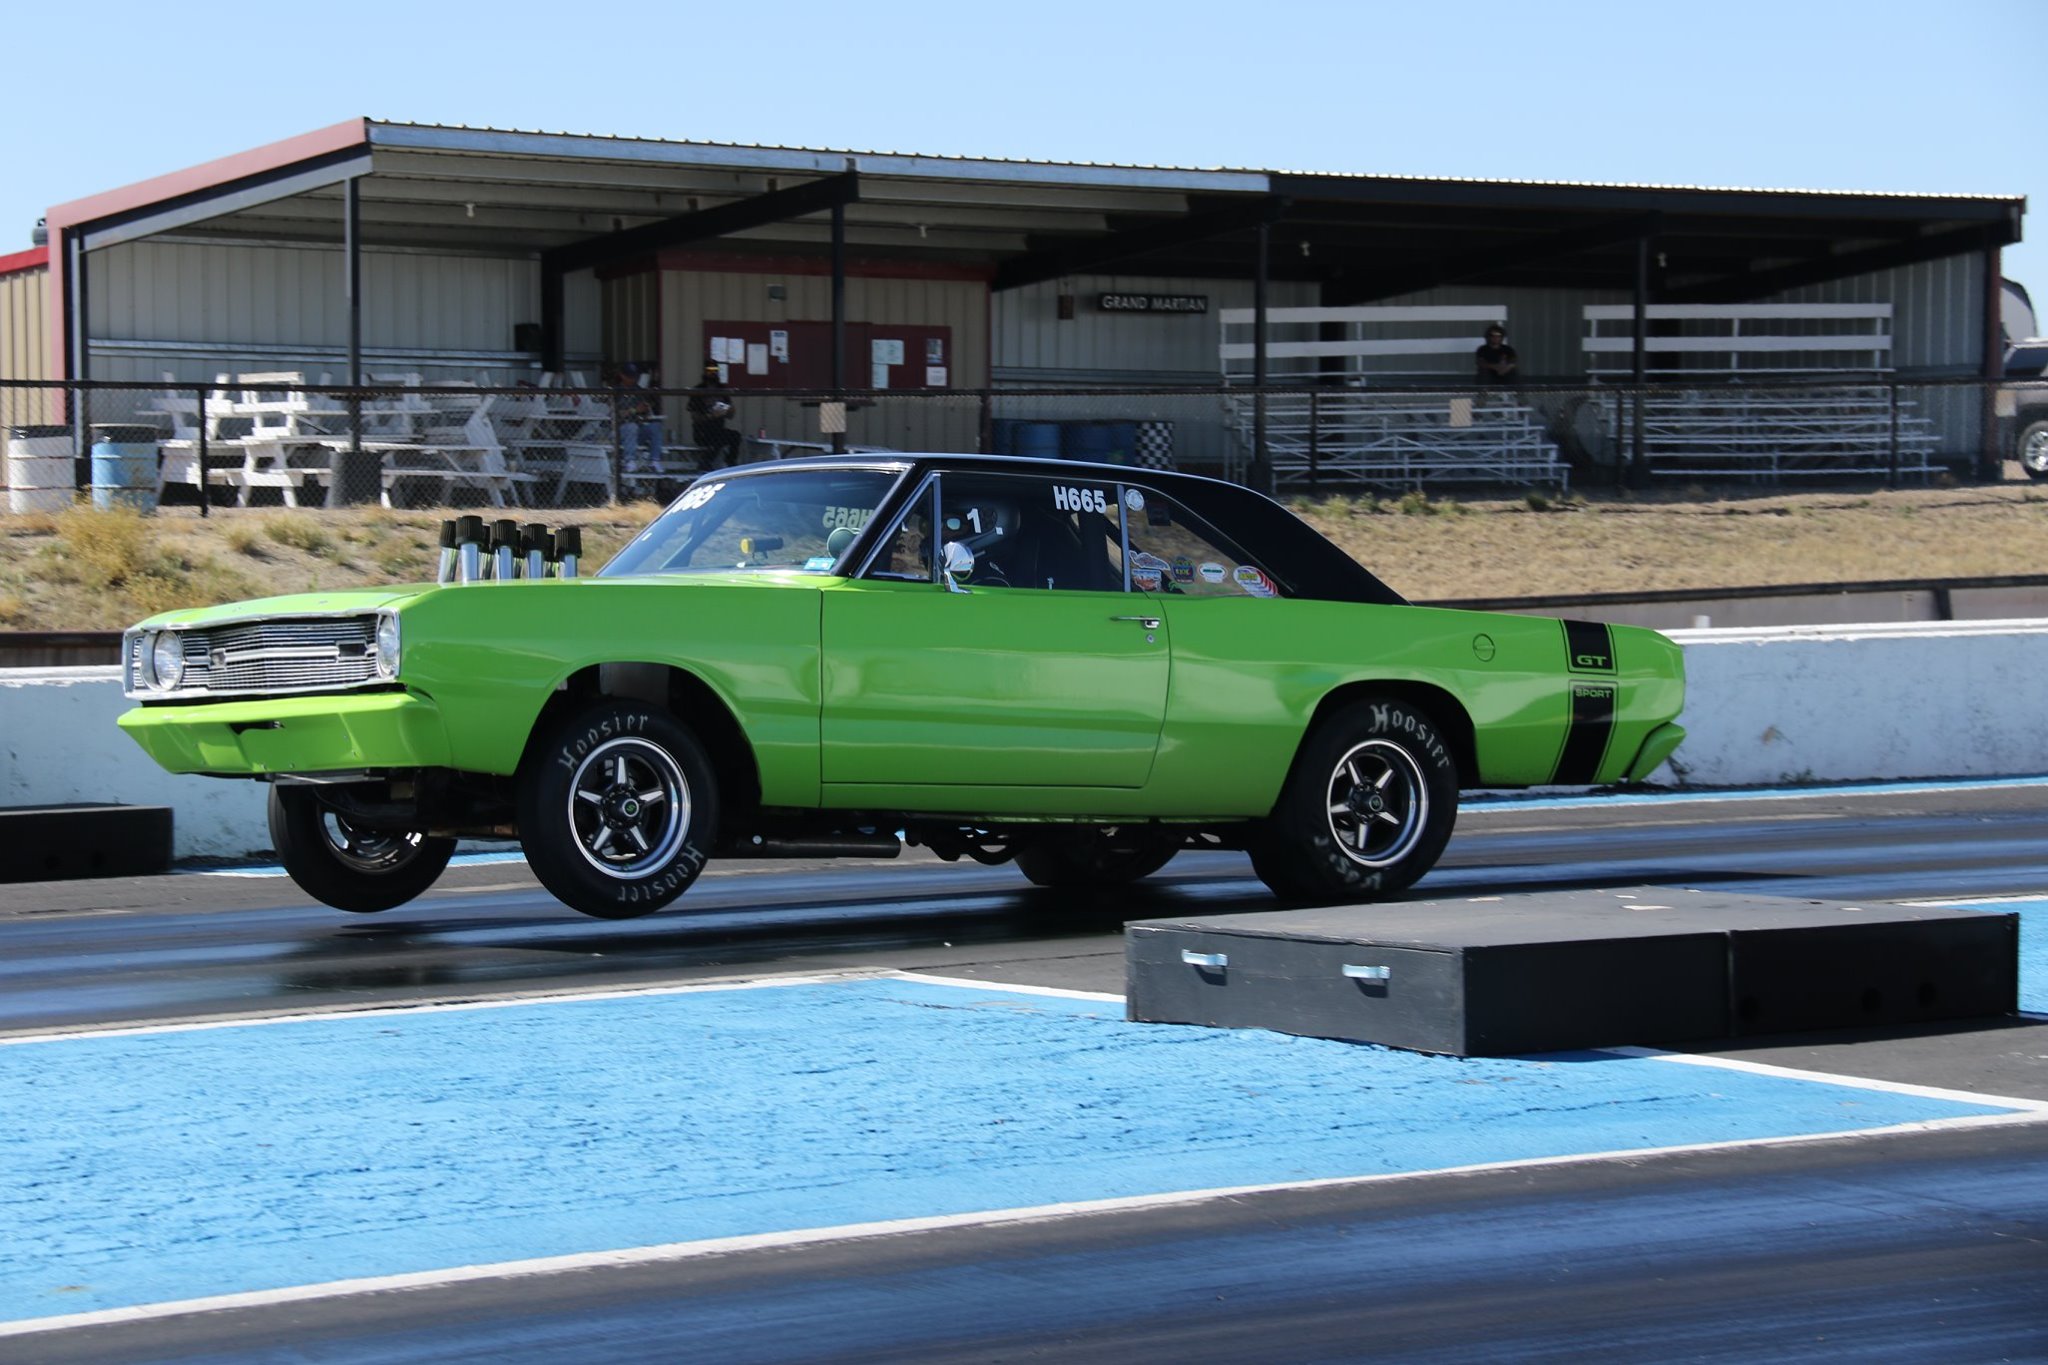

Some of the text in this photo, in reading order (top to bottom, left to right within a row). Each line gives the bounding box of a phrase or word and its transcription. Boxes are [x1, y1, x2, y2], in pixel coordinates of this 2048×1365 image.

[1102, 295, 1205, 311] GRAND MARTIAN
[1053, 485, 1107, 514] H665
[1577, 654, 1607, 666] GT
[1575, 688, 1612, 698] SPORT
[558, 711, 649, 775] Hoosier
[1368, 703, 1450, 768] Hoosier
[617, 841, 705, 901] Hoosier
